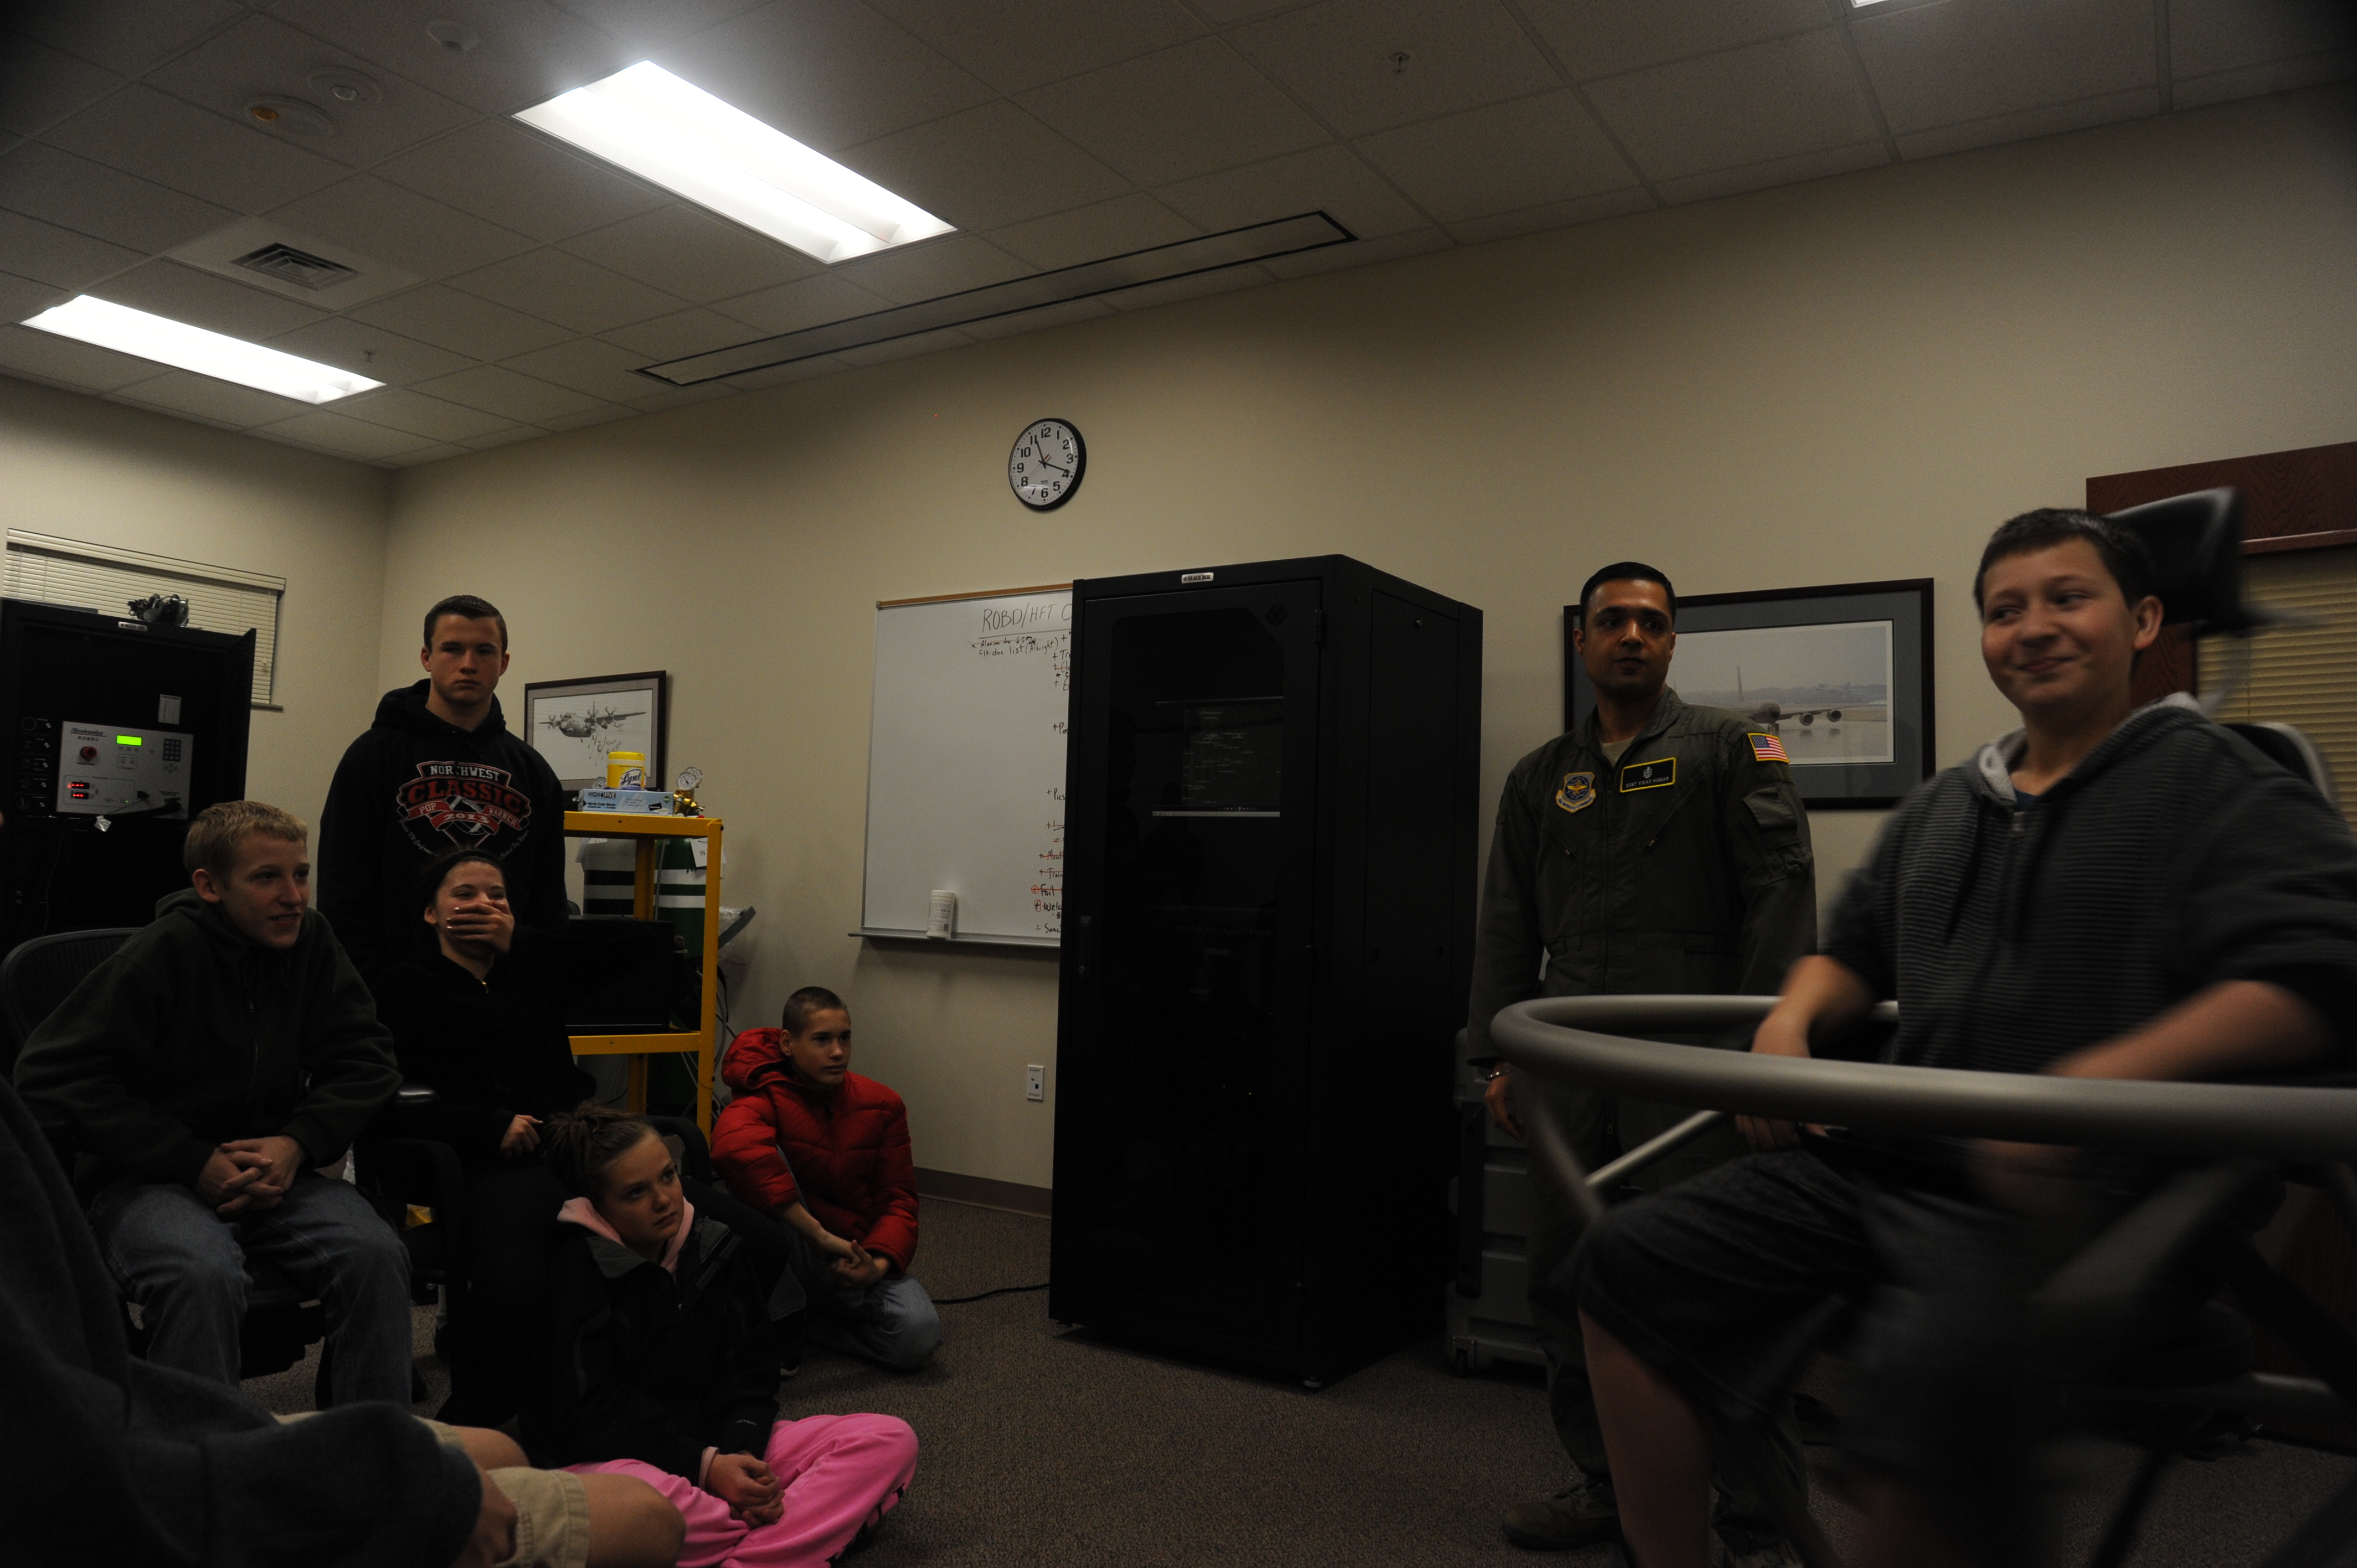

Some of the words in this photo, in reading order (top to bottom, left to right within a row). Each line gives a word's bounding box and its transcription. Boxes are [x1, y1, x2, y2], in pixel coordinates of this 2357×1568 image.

[1041, 427, 1051, 439] 12
[1057, 430, 1059, 440] 1
[1030, 435, 1037, 445] 11
[1062, 439, 1070, 450] 2
[1021, 447, 1031, 458] 10
[1066, 453, 1074, 464] 3
[1017, 462, 1025, 473] 9
[1062, 470, 1070, 478] 4
[1021, 476, 1028, 487] 8
[1053, 481, 1061, 492] 5
[1030, 484, 1037, 496] 7
[1041, 488, 1048, 498] 6
[1010, 644, 1025, 654] list
[620, 771, 642, 785] Lysol
[408, 780, 522, 814] CLASSIC
[418, 802, 436, 815] POP
[489, 807, 518, 826] WARNER
[443, 812, 491, 824] 2013
[1220, 927, 1247, 936] Again
